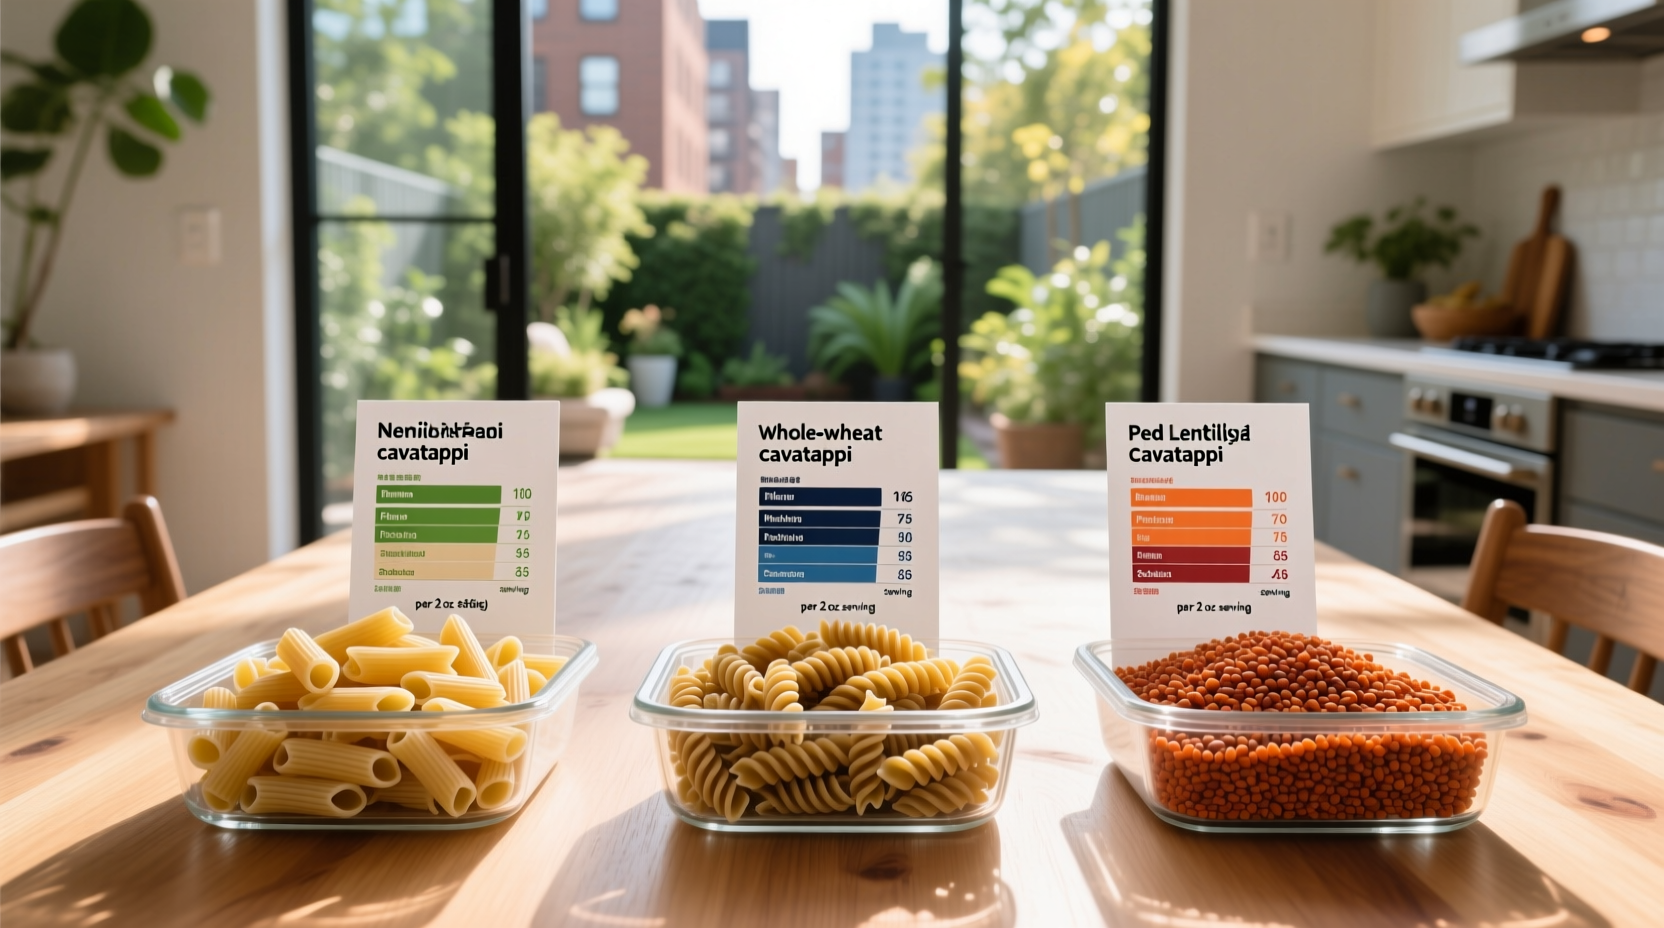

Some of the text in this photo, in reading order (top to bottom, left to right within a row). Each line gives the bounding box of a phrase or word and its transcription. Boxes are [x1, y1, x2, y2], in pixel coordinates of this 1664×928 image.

[759, 423, 882, 440] Whole-wheat
[1129, 424, 1163, 441] Ped
[377, 443, 469, 465] cavatappi
[759, 446, 852, 466] cavatappi
[1129, 446, 1223, 466] Cavatappi
[1265, 491, 1287, 503] 100
[1272, 514, 1287, 524] 70
[416, 600, 433, 610] per
[435, 598, 441, 608] 2
[801, 603, 817, 613] per
[820, 601, 826, 611] 2
[1196, 602, 1203, 611] 2
